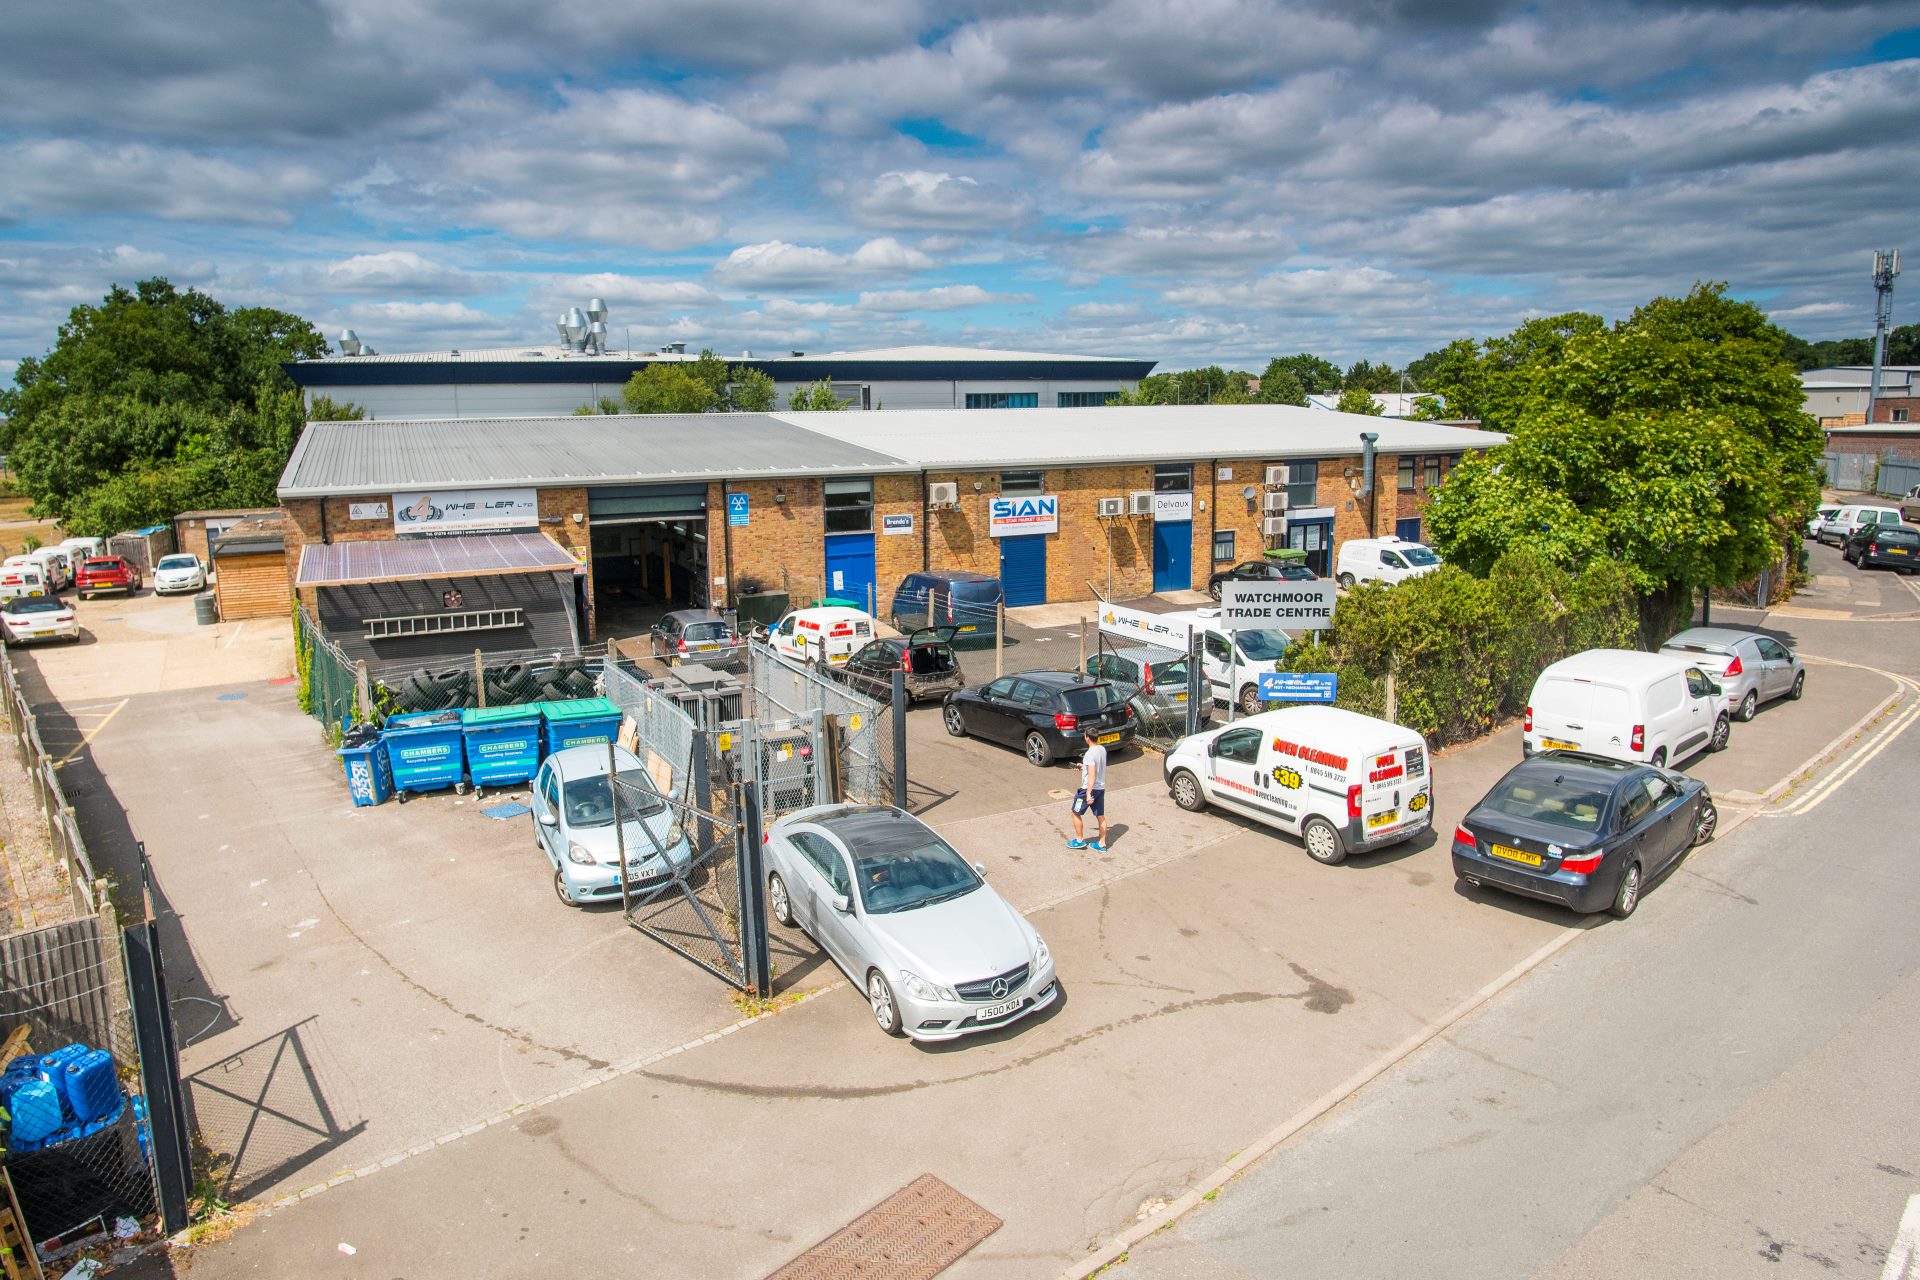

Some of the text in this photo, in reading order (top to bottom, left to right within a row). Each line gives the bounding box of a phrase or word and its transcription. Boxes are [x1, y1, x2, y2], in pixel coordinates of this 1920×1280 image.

[445, 501, 515, 511] WHEELER
[1157, 500, 1189, 509] Delvaux
[1234, 593, 1323, 603] WATCHMOOR
[1227, 607, 1330, 617] TRADE CENTRE
[1118, 616, 1169, 634] WHEELER
[1264, 677, 1274, 689] 4
[481, 742, 524, 751] CHAMBERS
[566, 737, 606, 746] CHAMBERS
[404, 746, 448, 757] CHAMBERS
[1273, 736, 1348, 771] OVEN CLEANING
[1376, 753, 1395, 768] OVEN
[1310, 766, 1323, 776] 0845
[1369, 764, 1403, 783] CLEANING
[1496, 846, 1518, 858] DV08
[981, 998, 1020, 1018] J500 KDA
